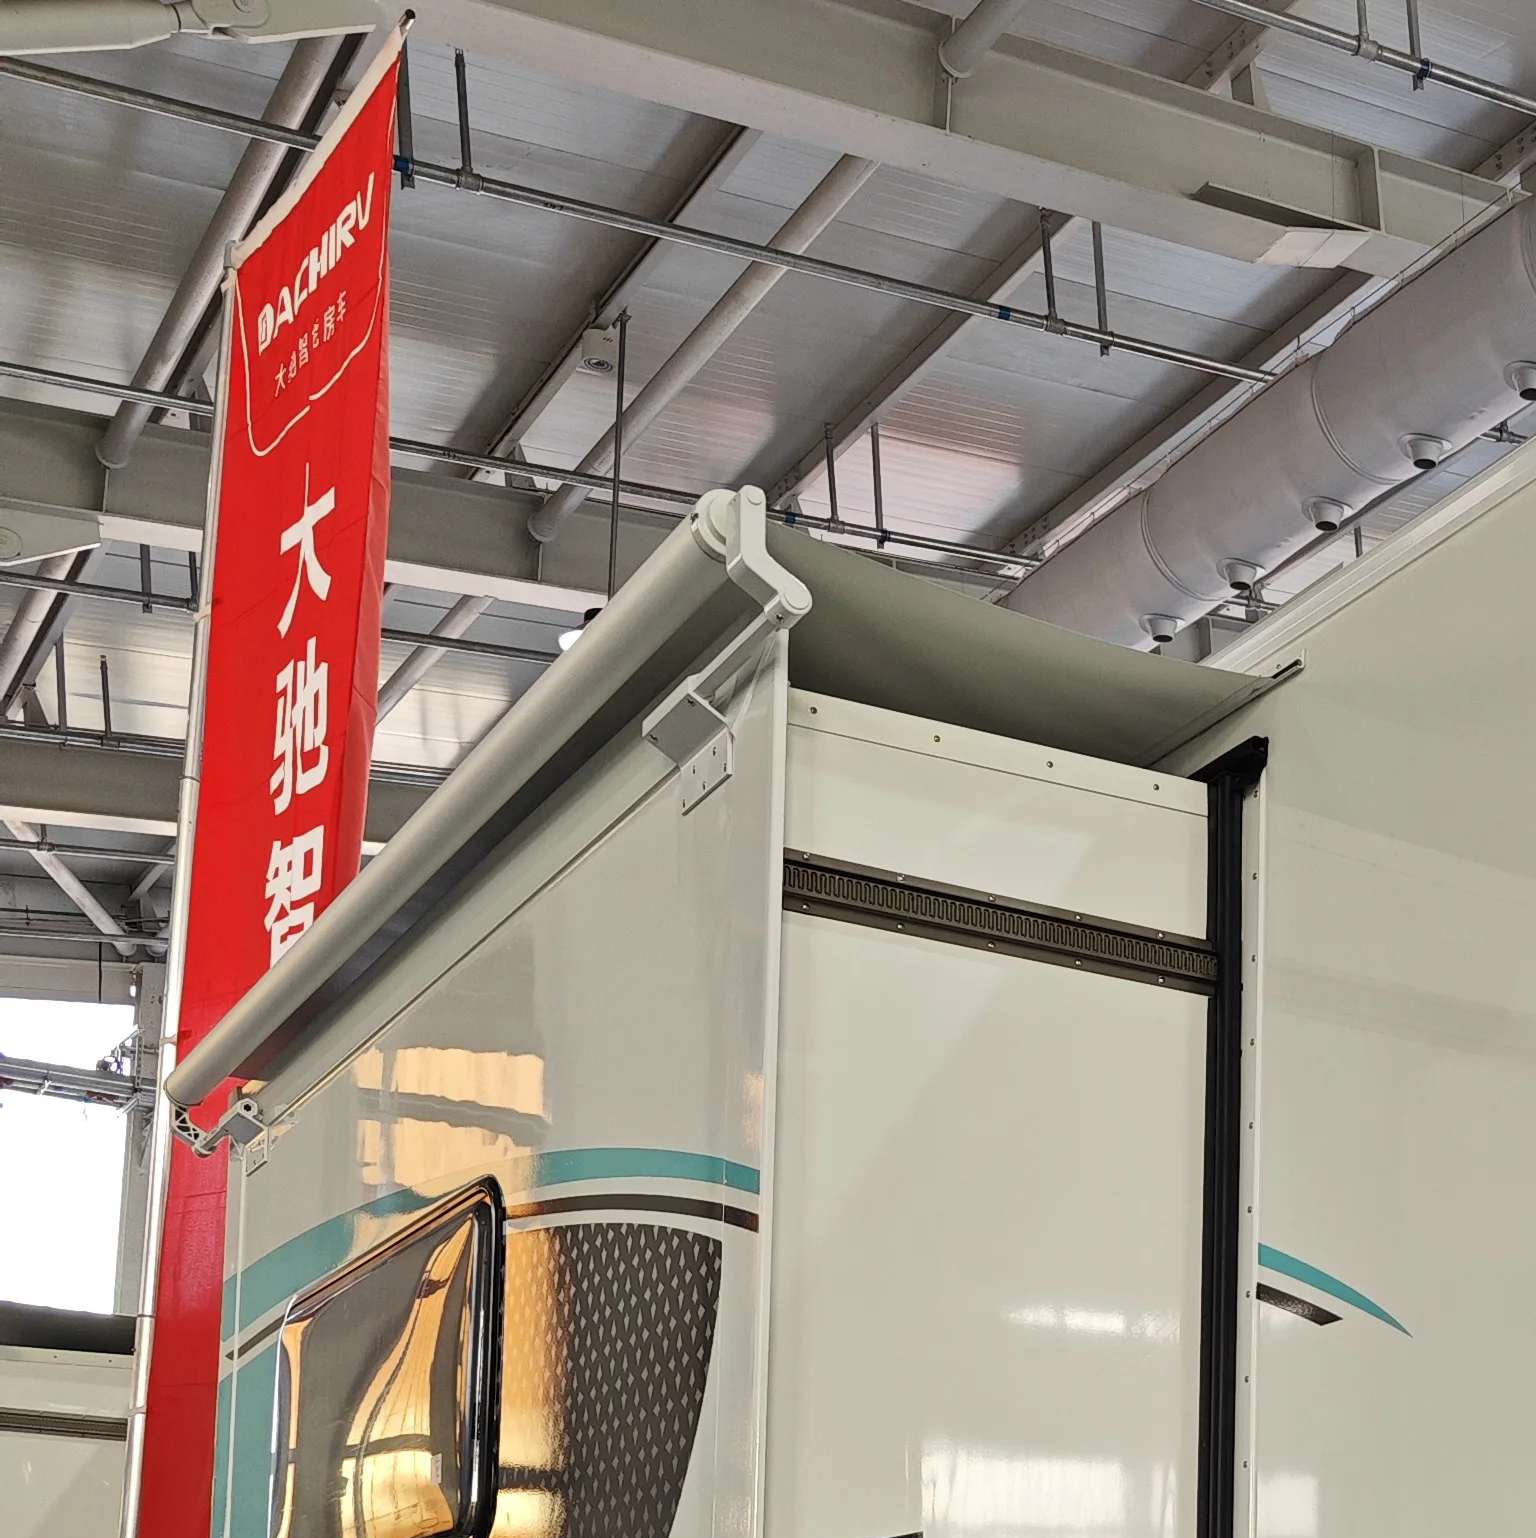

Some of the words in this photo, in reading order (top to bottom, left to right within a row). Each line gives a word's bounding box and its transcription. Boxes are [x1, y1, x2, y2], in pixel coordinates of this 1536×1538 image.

[257, 171, 375, 356] DACHIRV
[264, 461, 336, 969] 大驰智
